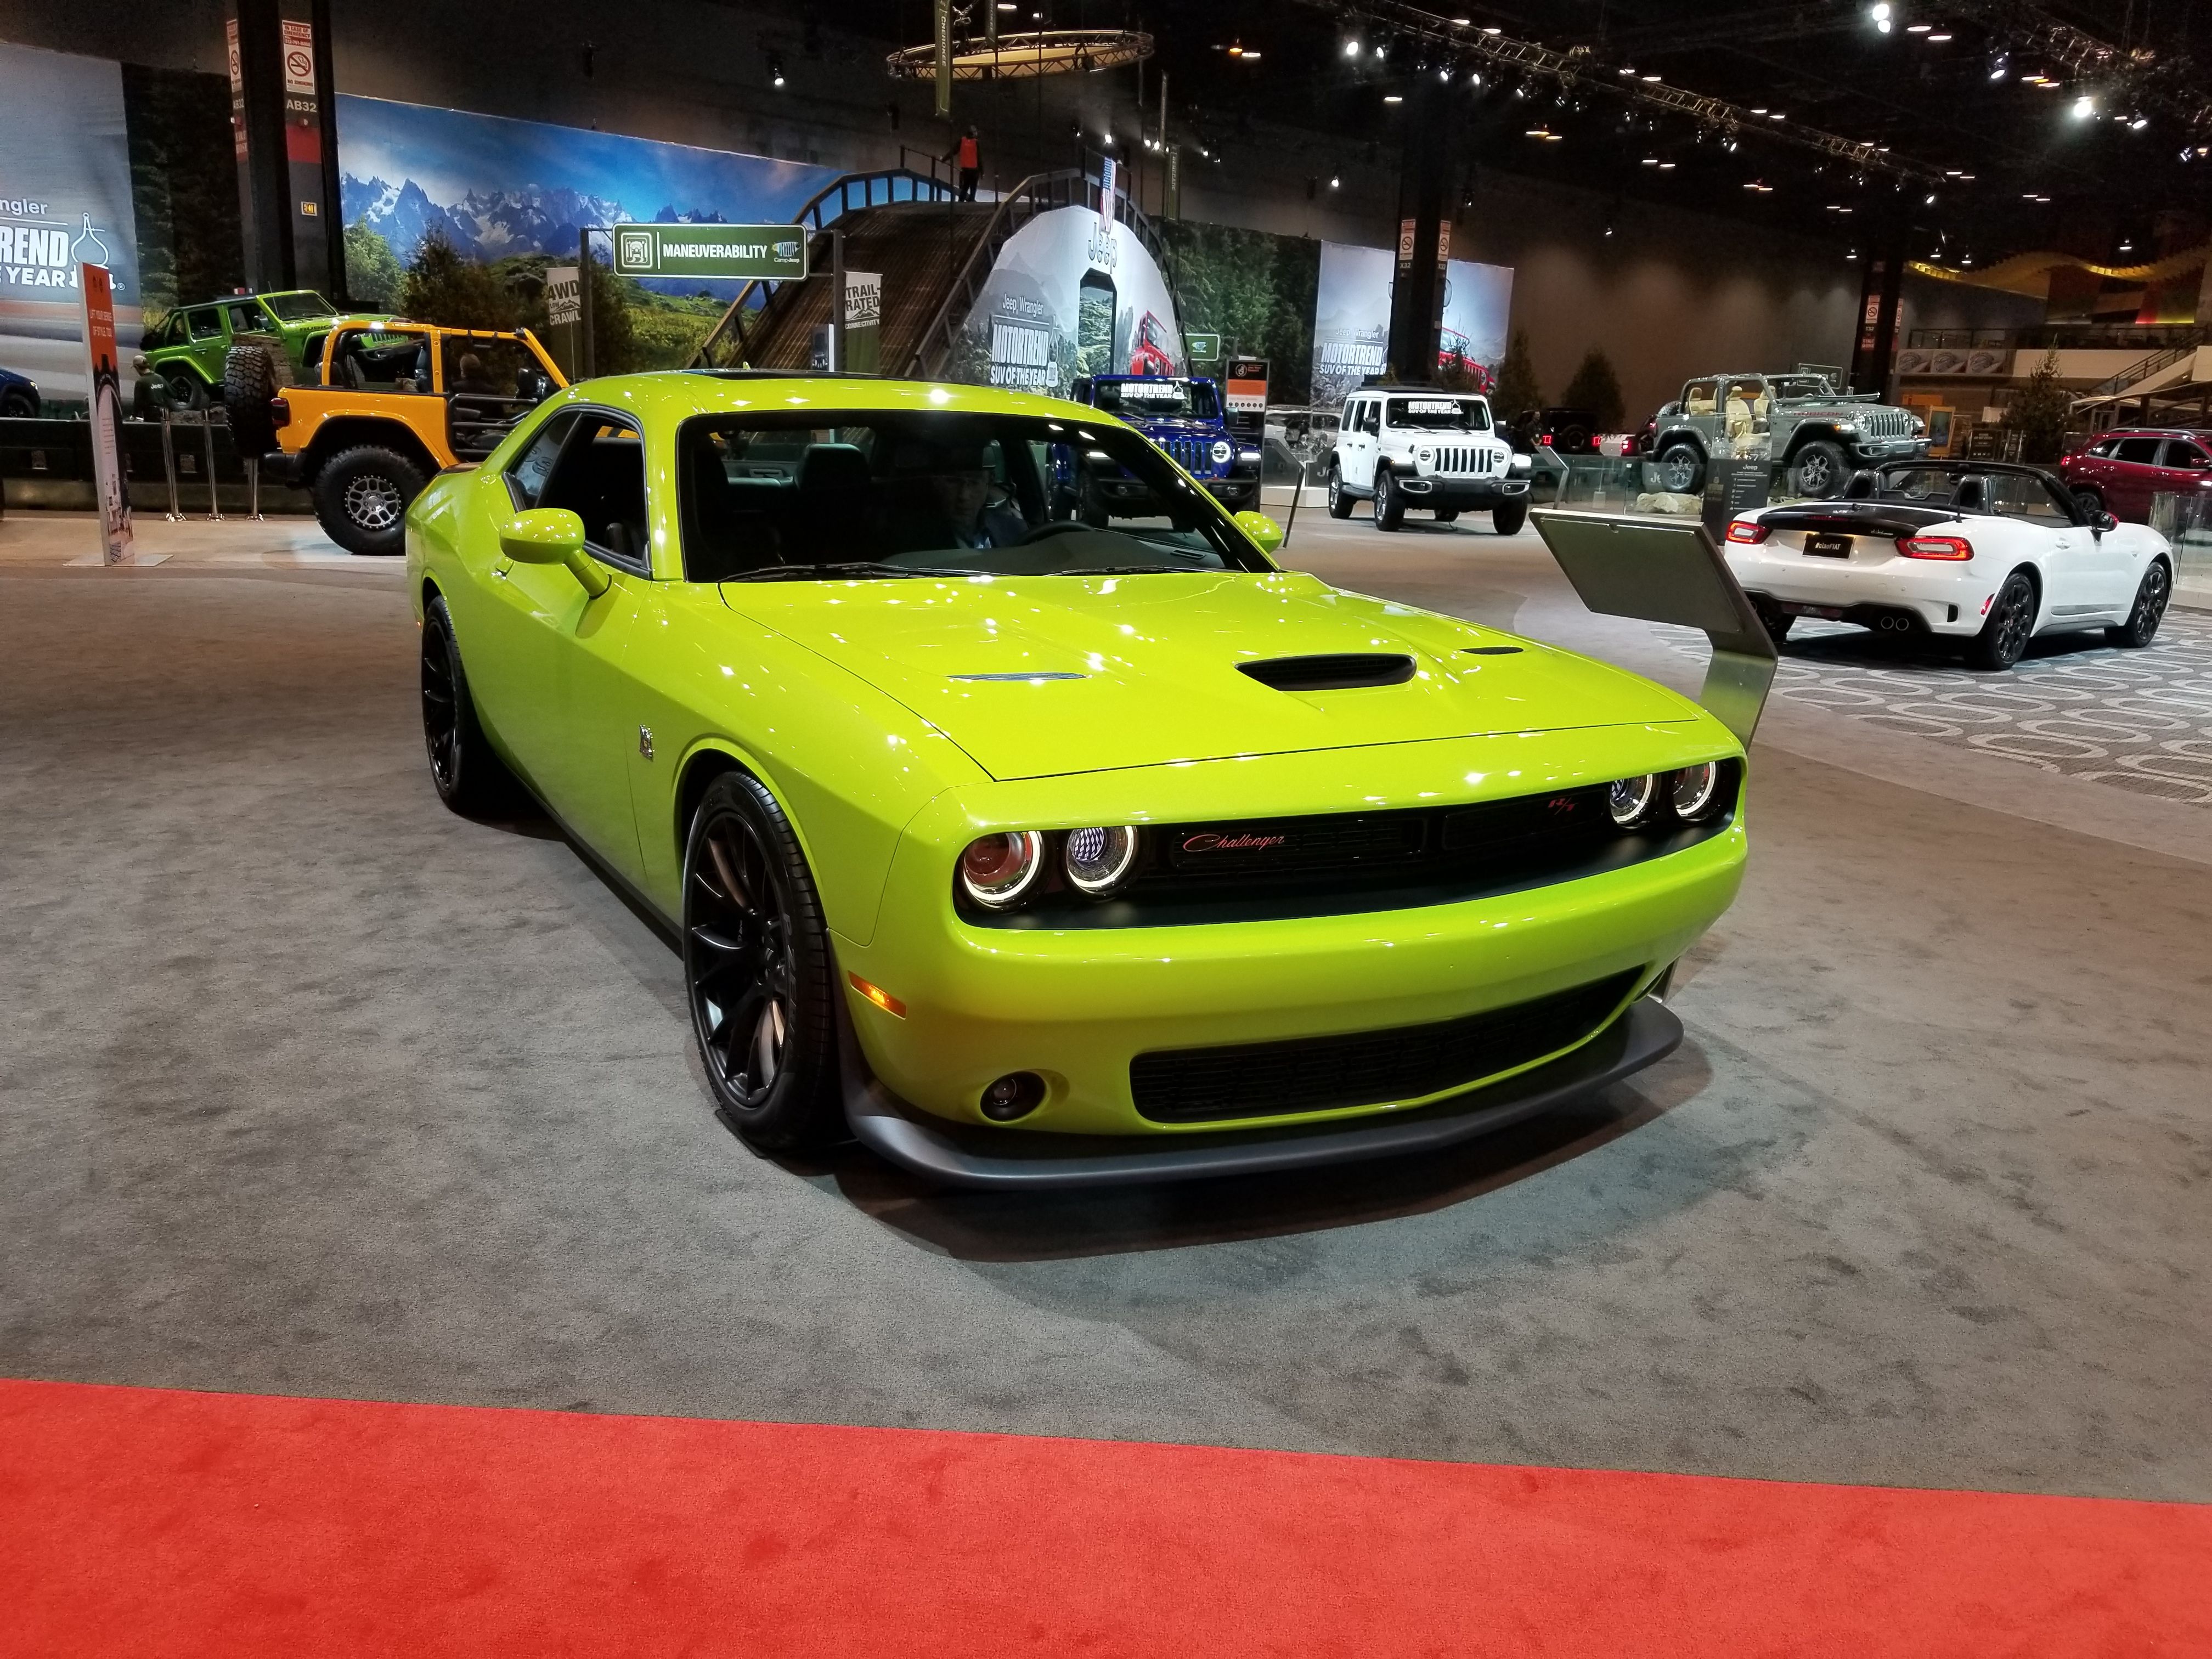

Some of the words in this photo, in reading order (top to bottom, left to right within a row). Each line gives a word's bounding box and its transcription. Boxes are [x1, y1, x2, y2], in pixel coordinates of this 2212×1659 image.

[286, 99, 317, 112] AB32
[303, 203, 315, 214] EXIT
[663, 244, 768, 258] MANEUVERABILITY
[1087, 222, 1118, 274] Jeep
[5, 266, 66, 287] YEAR
[845, 296, 881, 312] RATED
[1002, 294, 1017, 314] Jeep
[1019, 296, 1043, 318] Wrangler
[550, 310, 582, 326] CRAWL
[1336, 328, 1351, 336] Jeep
[1355, 329, 1379, 340] Wrangler
[991, 324, 1049, 366] MOTORTREND
[1321, 342, 1384, 366] MOTORTREND
[990, 364, 1006, 384] SUV
[1006, 366, 1015, 385] OF
[1016, 367, 1030, 385] THE
[1029, 367, 1046, 386] YEAR
[1319, 364, 1335, 374] SUV
[1335, 365, 1347, 375] OF
[1347, 365, 1361, 376] THE
[1361, 366, 1380, 375] YEAR
[1121, 383, 1173, 394] MOTORTREND
[1408, 401, 1452, 409] MOTORTREND
[1548, 796, 1579, 815] R/T
[1183, 833, 1285, 851] Challenger
